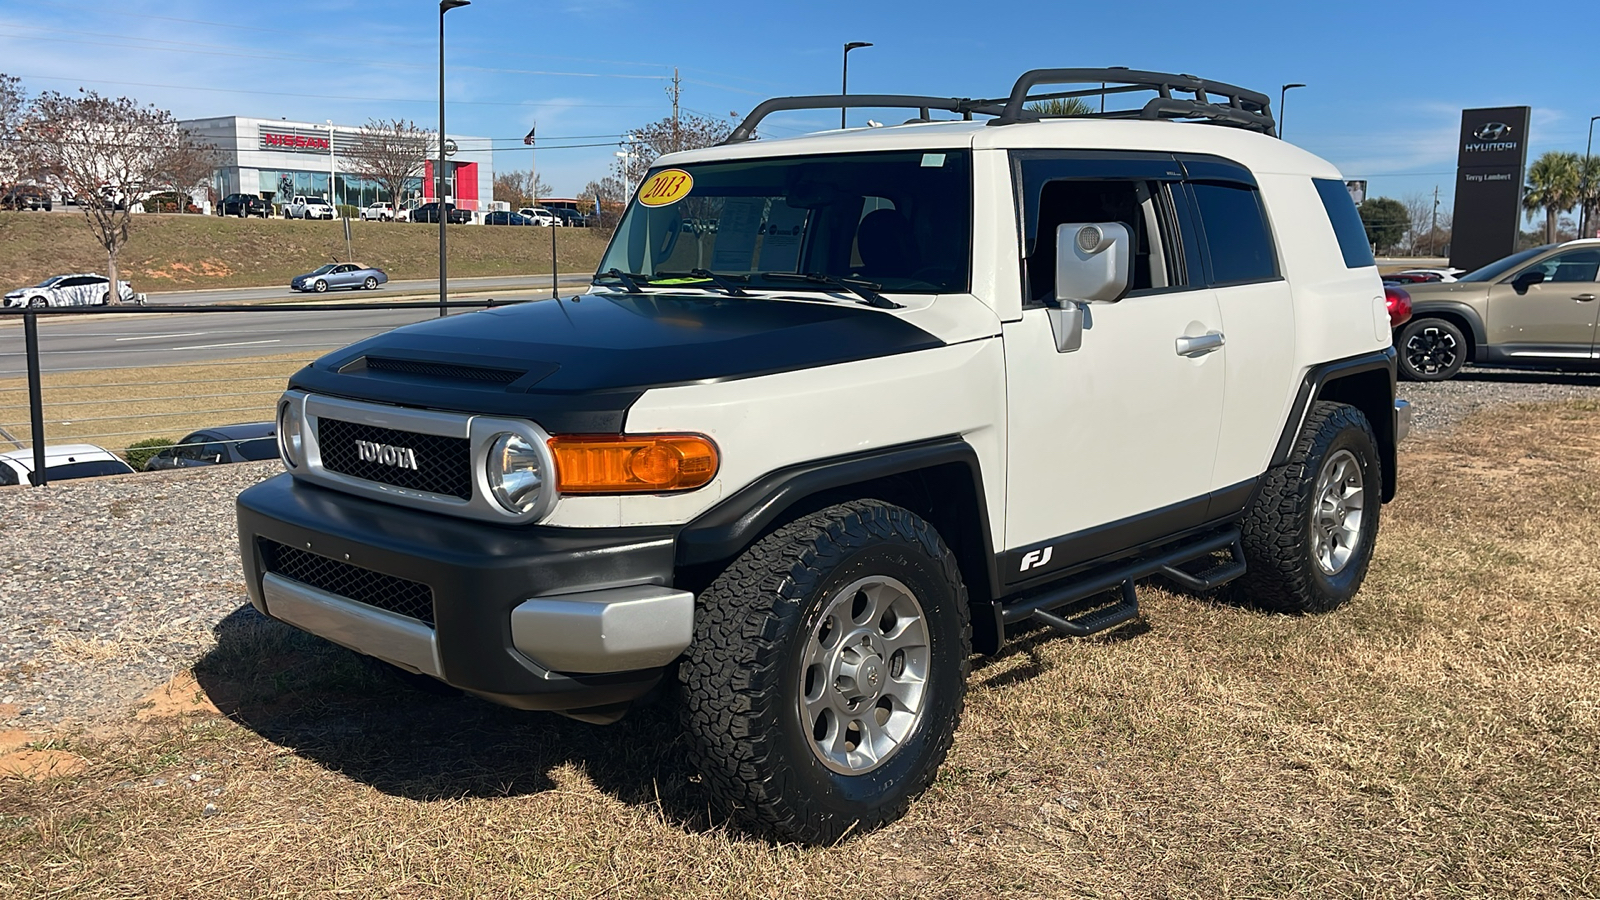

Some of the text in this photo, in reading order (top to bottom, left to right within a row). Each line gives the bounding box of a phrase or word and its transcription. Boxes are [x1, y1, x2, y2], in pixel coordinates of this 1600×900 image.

[265, 133, 329, 149] NISSAN
[1465, 142, 1517, 152] HYUNDAI
[643, 175, 686, 199] 2013
[1465, 174, 1483, 182] Terry
[355, 439, 418, 470] TOYOTA
[1020, 546, 1053, 572] FJ
